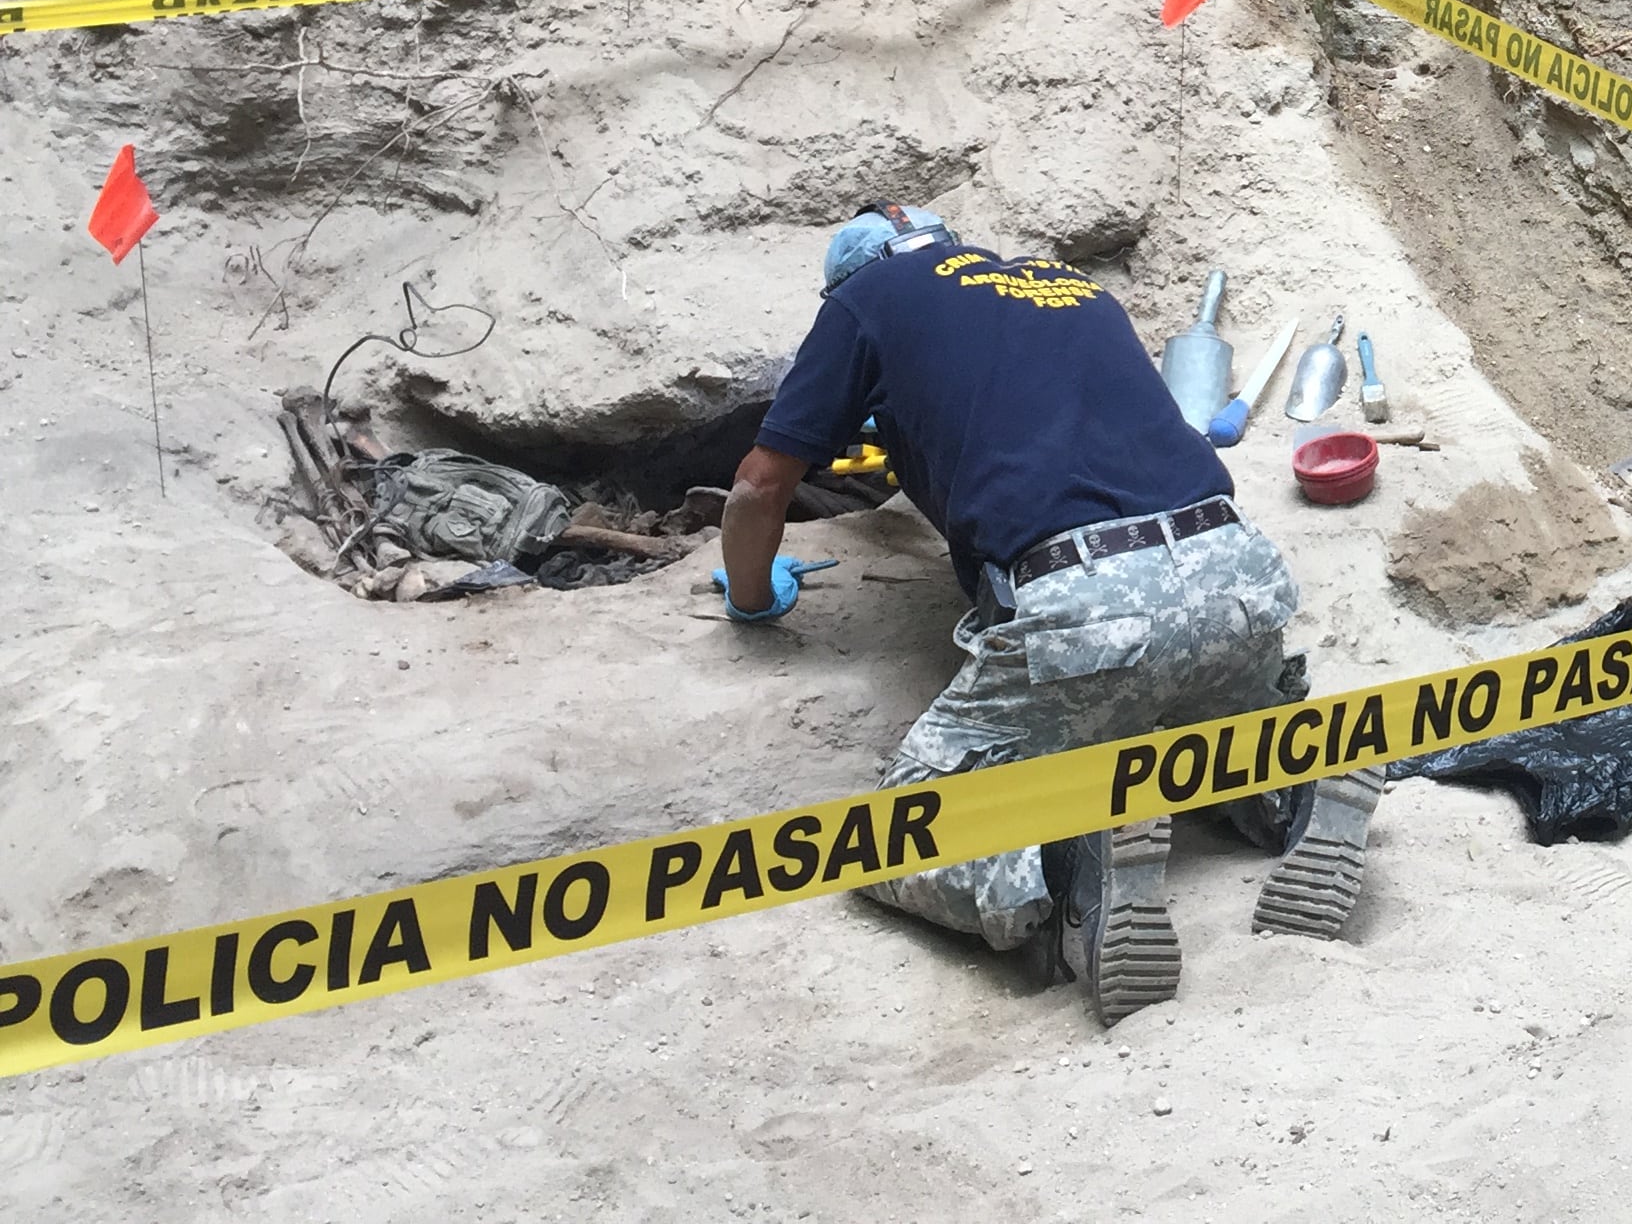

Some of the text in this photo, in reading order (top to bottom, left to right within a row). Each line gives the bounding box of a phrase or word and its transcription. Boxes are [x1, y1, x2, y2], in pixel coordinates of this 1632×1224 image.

[995, 284, 1098, 299] FORENSE
[1033, 296, 1081, 308] FGR
[1110, 694, 1389, 816] POLICIA
[1411, 668, 1501, 745] NO
[0, 790, 942, 1045] POLICIA NO PASAR
